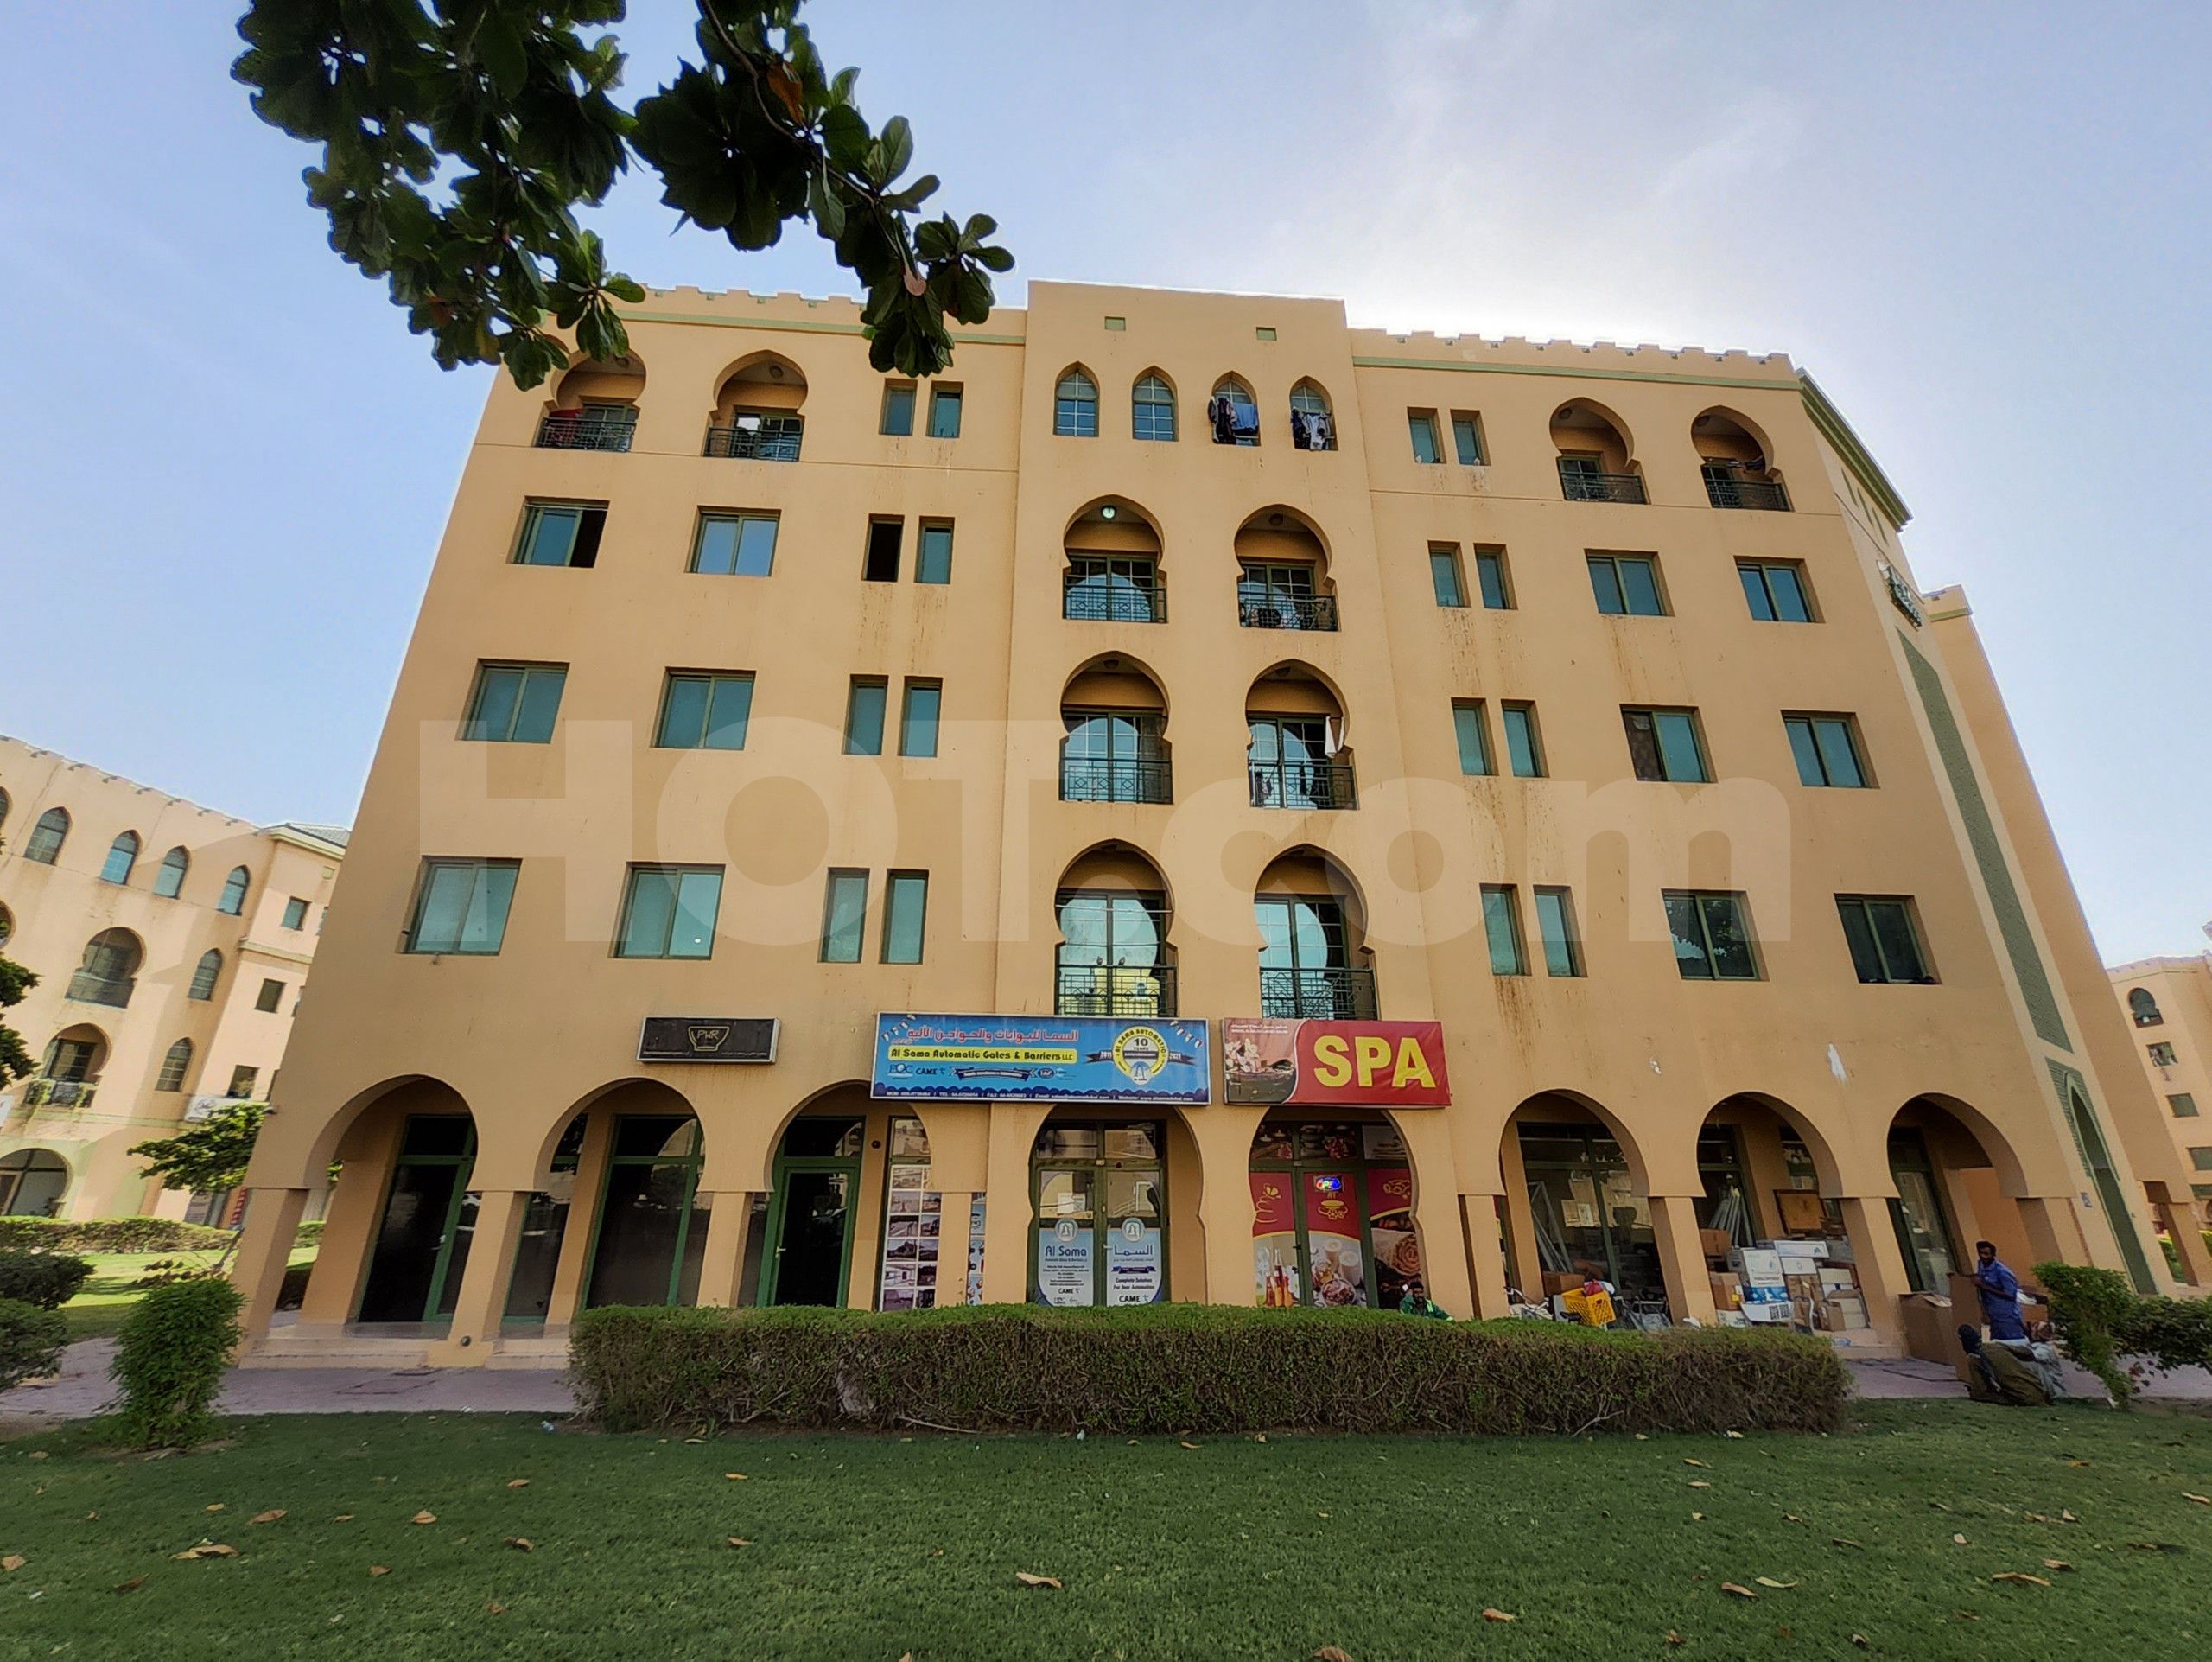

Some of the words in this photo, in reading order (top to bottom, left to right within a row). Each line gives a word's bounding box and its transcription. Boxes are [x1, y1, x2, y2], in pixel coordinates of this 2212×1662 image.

[903, 1048, 931, 1058] Sama
[933, 1049, 980, 1059] Automatic
[983, 1050, 1011, 1060] Gates
[1014, 1051, 1020, 1060] &
[1024, 1052, 1061, 1060] Barriers
[1313, 1035, 1436, 1088] SPA
[1058, 1245, 1087, 1257] Sama
[1115, 1245, 1153, 1256] السما
